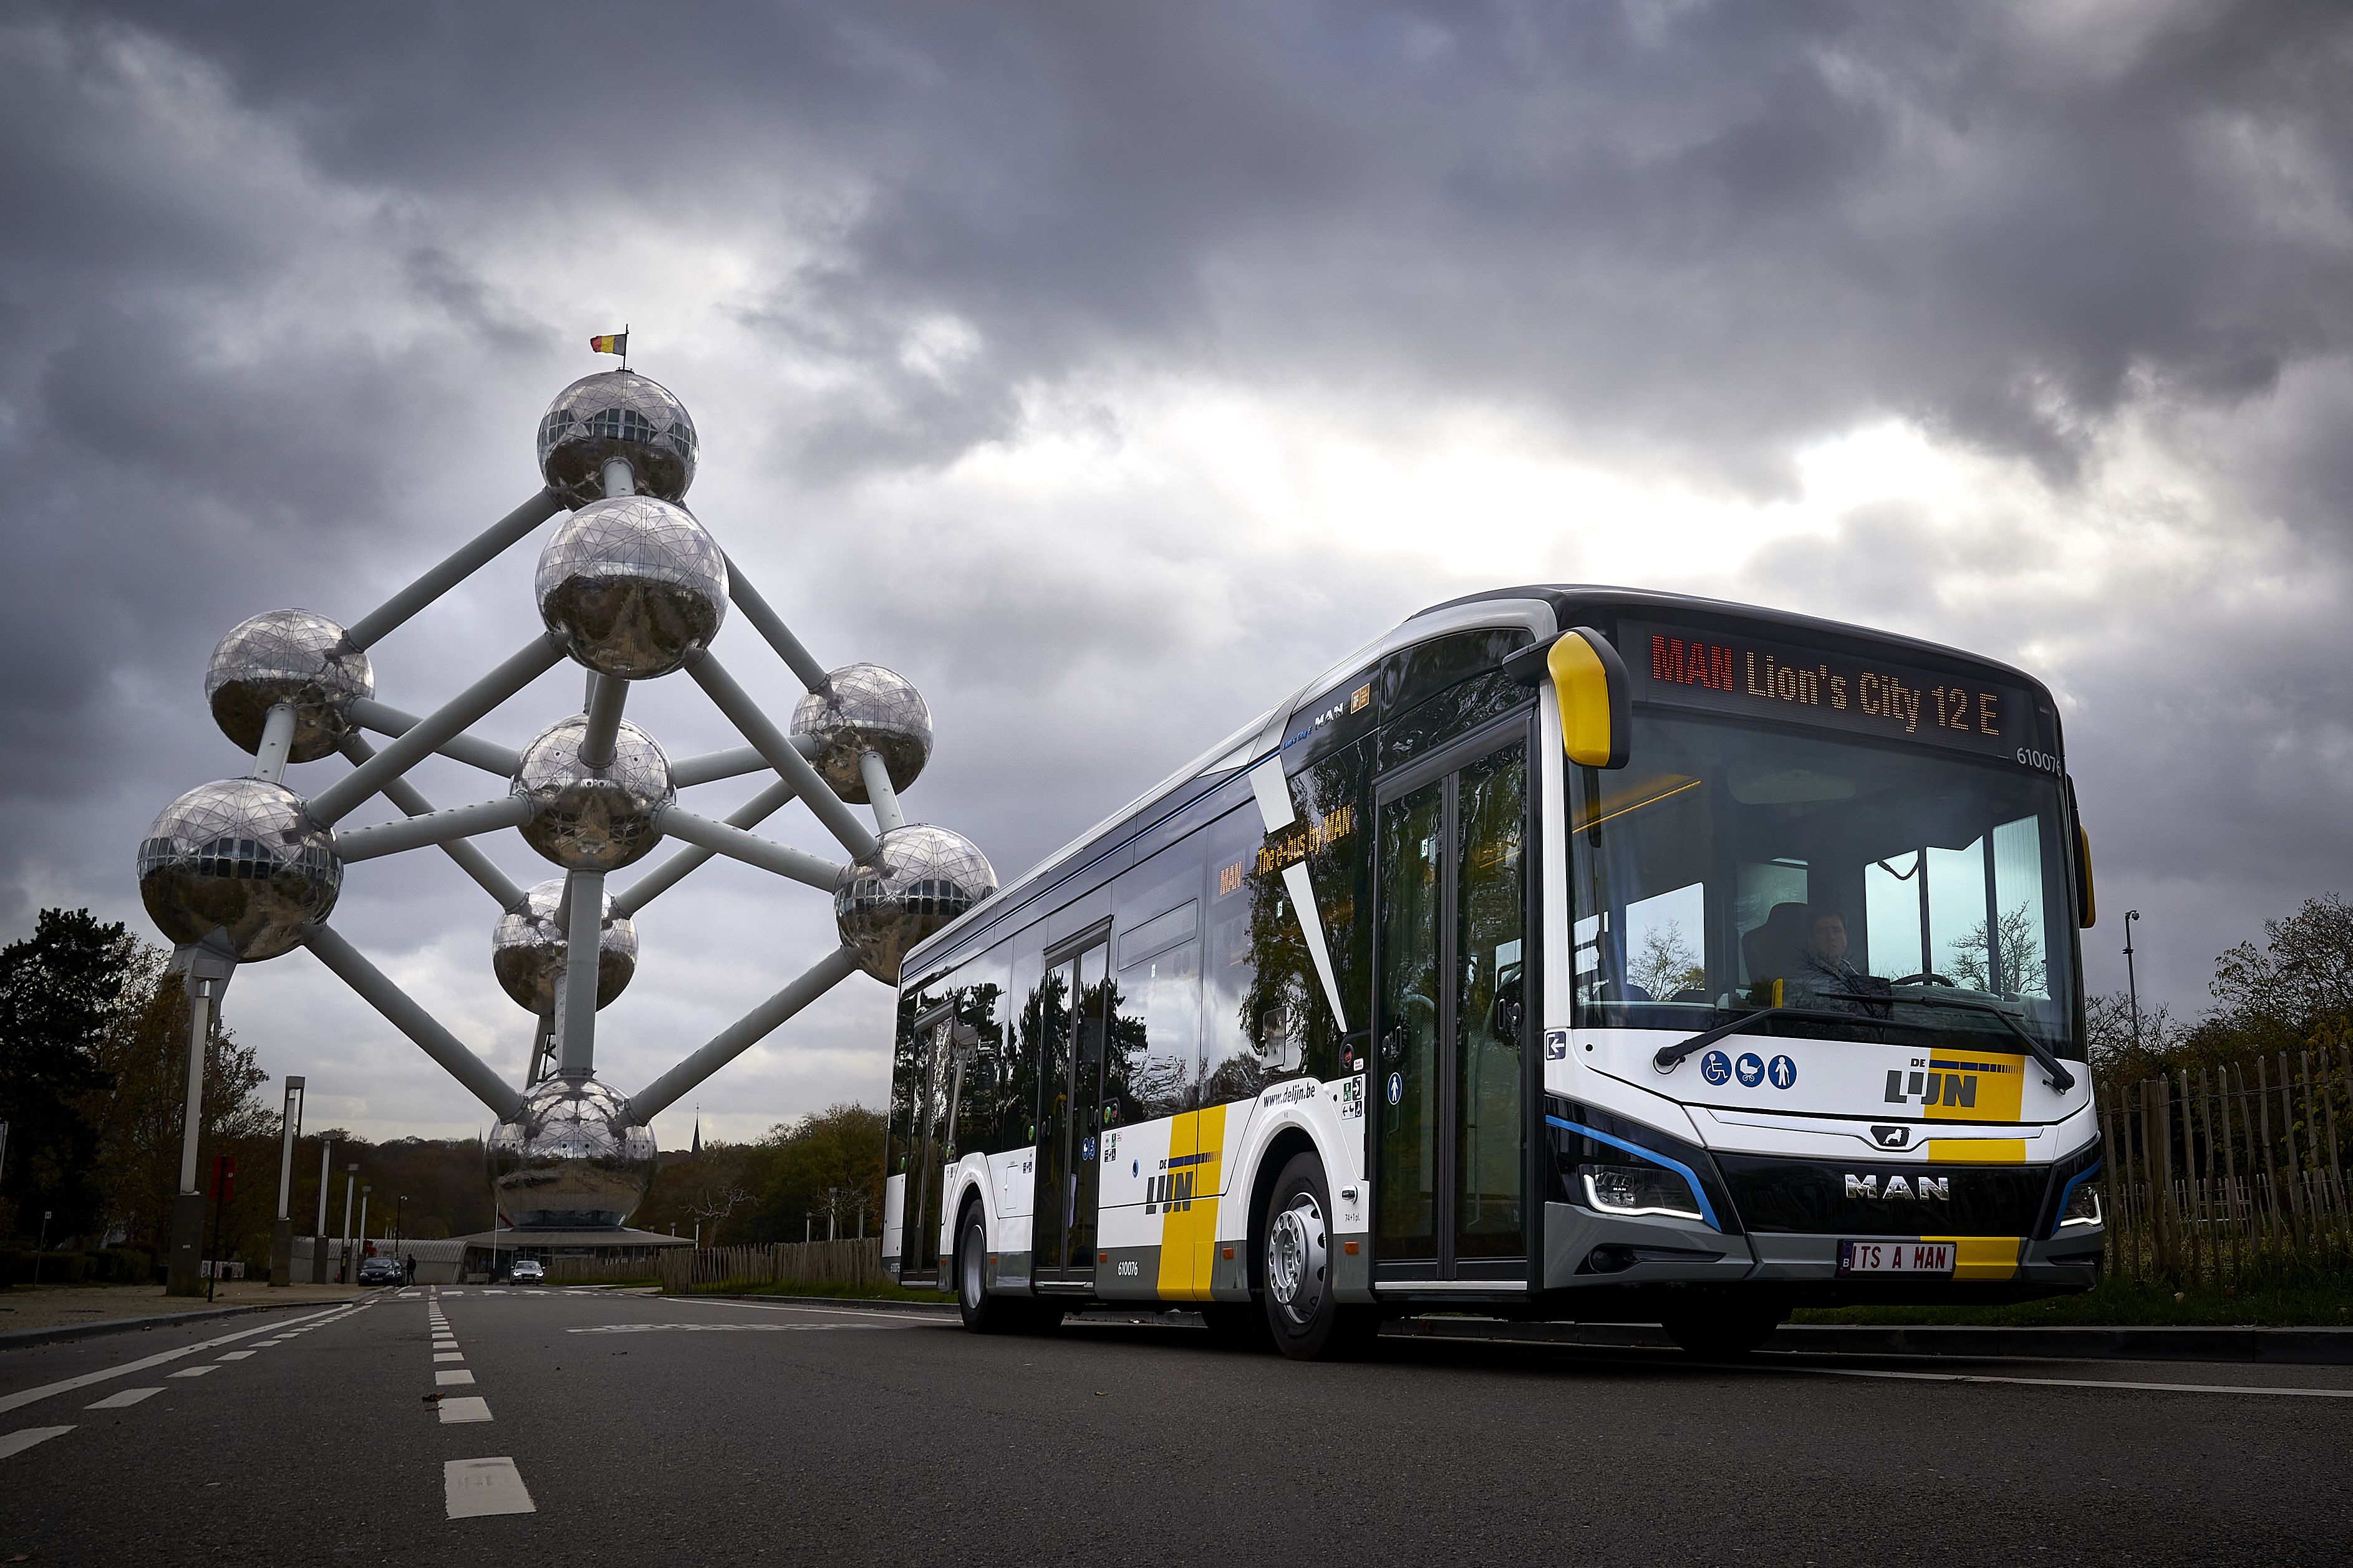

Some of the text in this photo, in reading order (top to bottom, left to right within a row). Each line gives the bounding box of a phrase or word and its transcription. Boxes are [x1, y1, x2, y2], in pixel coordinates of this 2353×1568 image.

[1652, 635, 1999, 736] MAN Lion's City 12 E
[1315, 702, 1344, 731] MAN
[1297, 731, 1308, 741] City
[2016, 747, 2062, 777] 610076
[1220, 804, 1351, 896] MAN The e-bus by MAN
[1910, 1058, 1926, 1067] DE
[1263, 1082, 1315, 1108] www.delijn.be
[1884, 1069, 1978, 1108] LIJN
[1159, 1159, 1167, 1170] DE
[1146, 1171, 1194, 1214] LIJN
[1845, 1174, 1950, 1201] MAN
[1118, 1261, 1138, 1276] 610076
[1843, 1258, 1850, 1267] B
[1851, 1246, 1946, 1269] ITS A MAN
